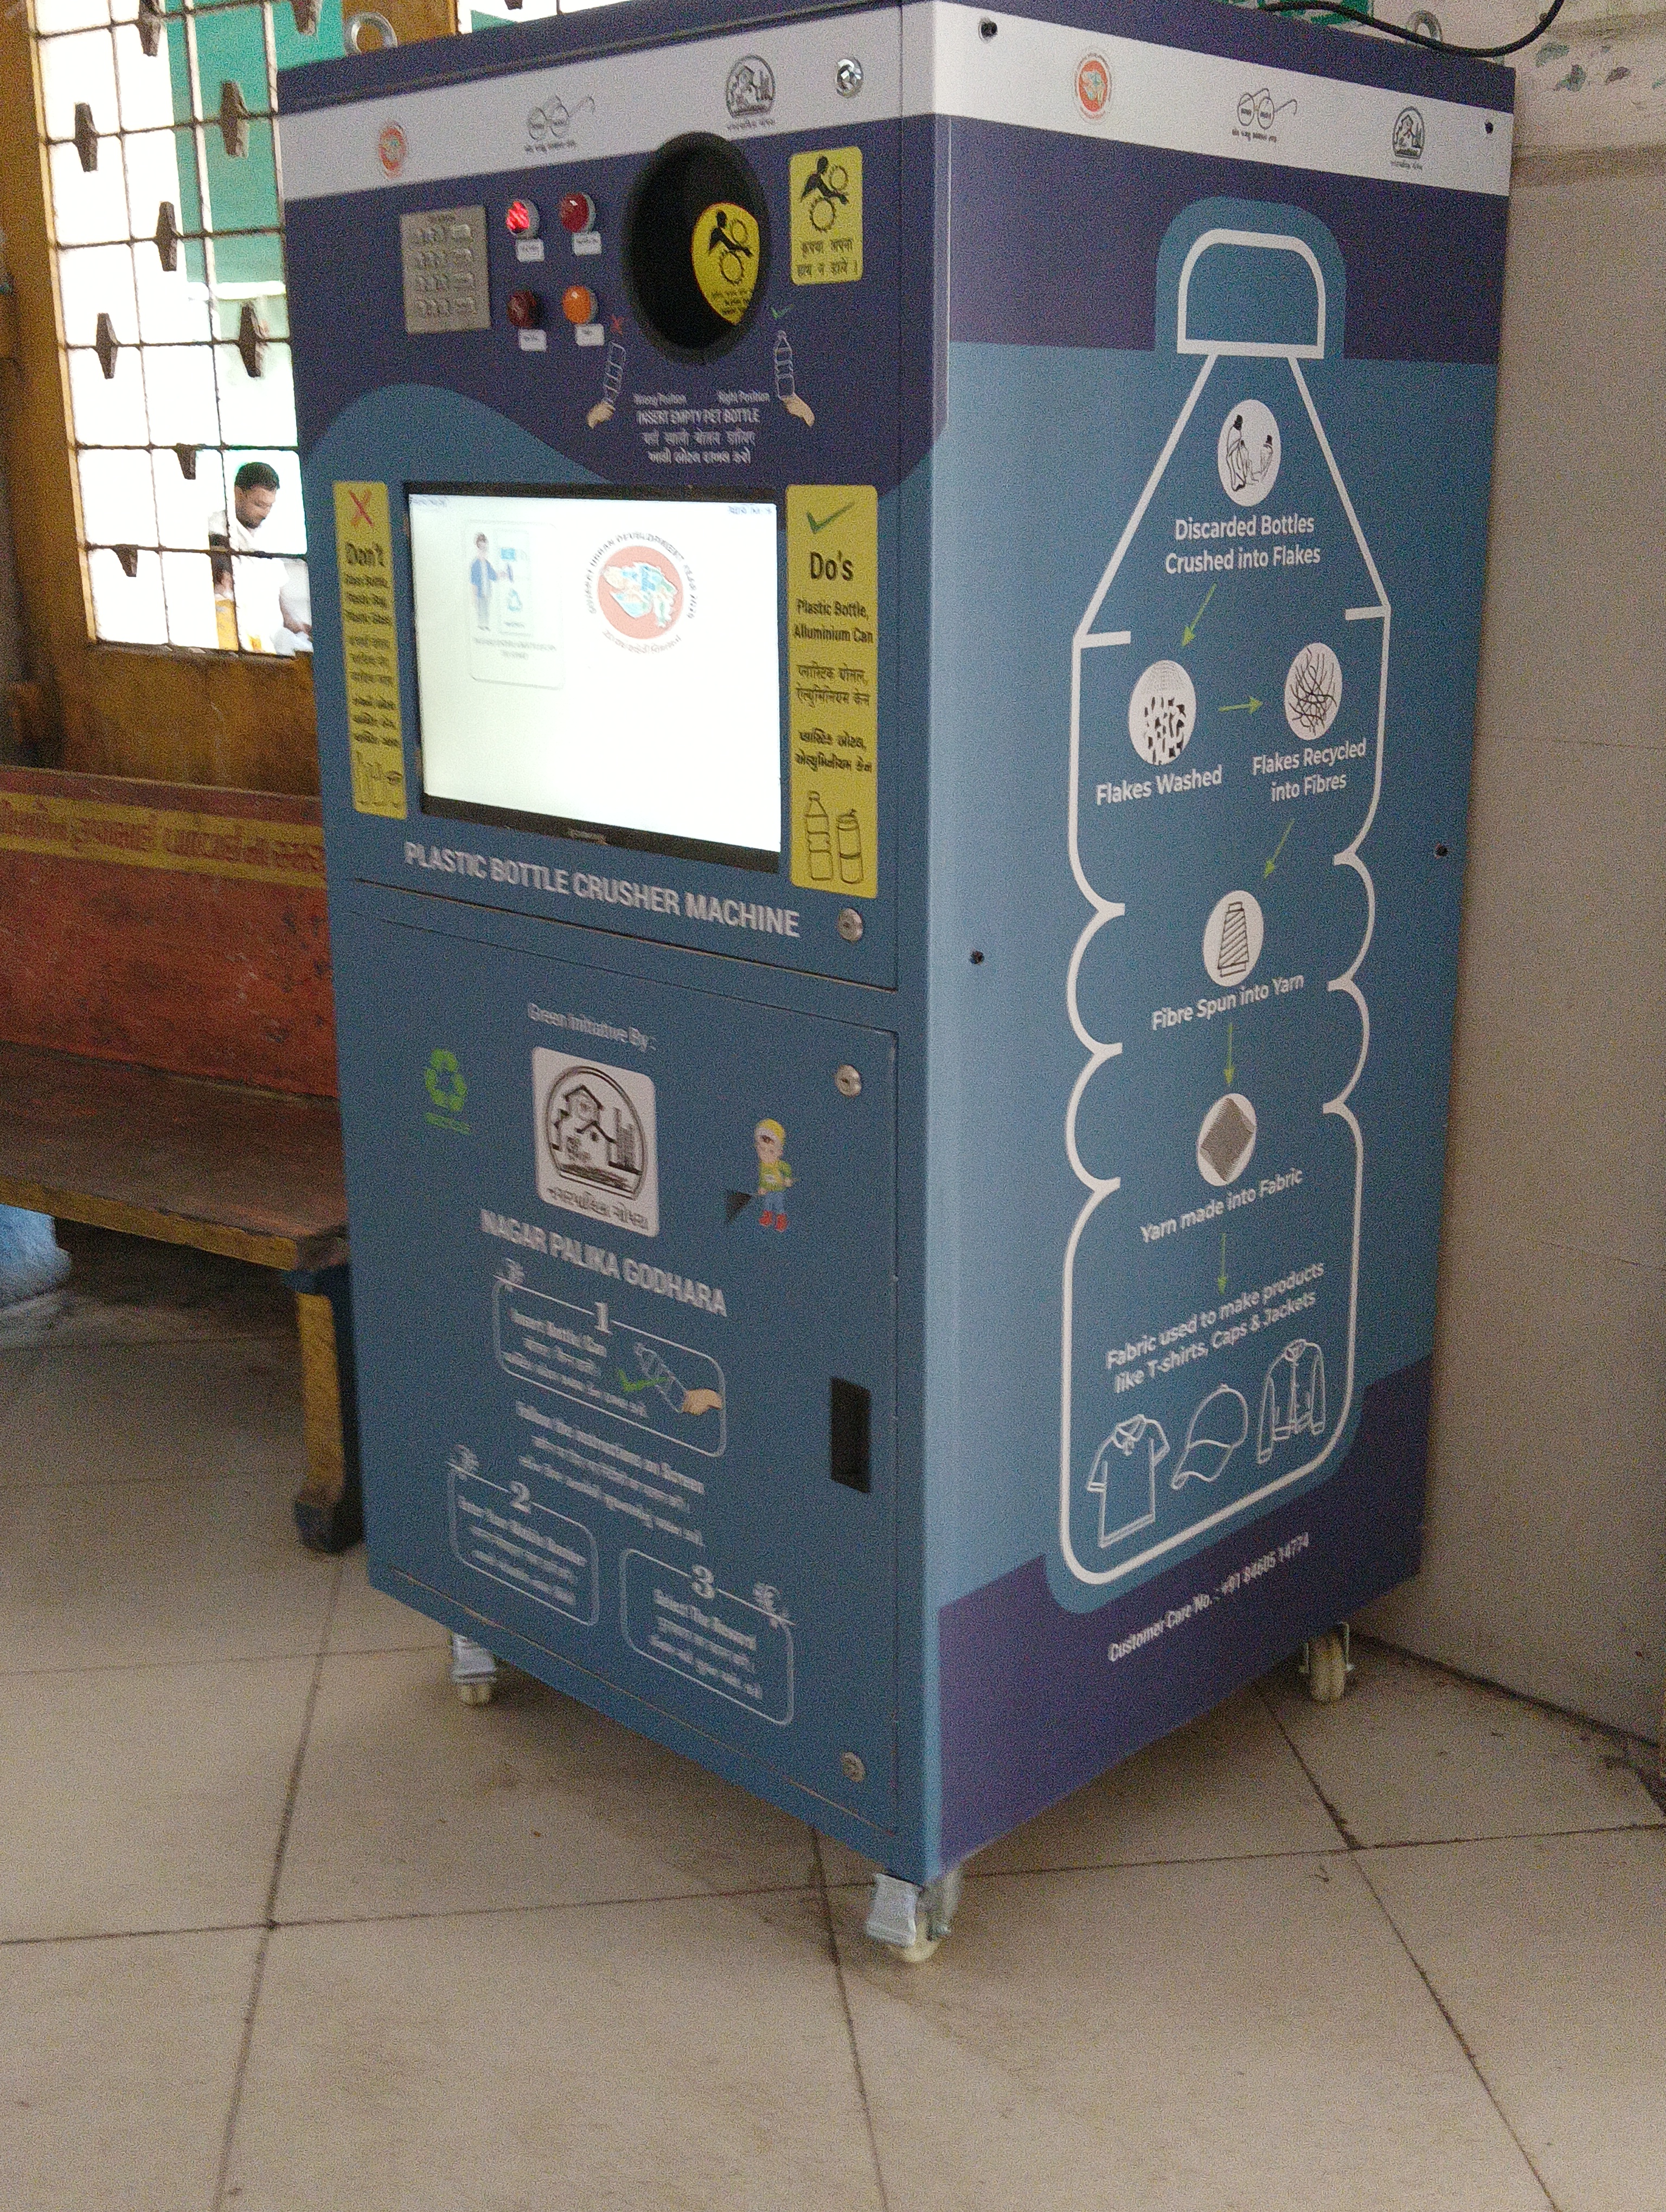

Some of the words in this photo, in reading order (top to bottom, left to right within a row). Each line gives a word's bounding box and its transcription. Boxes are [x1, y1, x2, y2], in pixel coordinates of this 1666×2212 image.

[723, 407, 760, 424] BOTTLE
[1175, 516, 1257, 541] Discarded
[1260, 513, 1315, 537] Bottles
[810, 550, 854, 581] Do's
[1164, 548, 1234, 576] Crushed
[1237, 546, 1269, 570] into
[1273, 544, 1322, 567] Flakes
[796, 598, 831, 617] Plastic
[853, 627, 874, 643] Can
[1252, 751, 1300, 776] Flakes
[1303, 737, 1367, 770] Recycled
[1096, 775, 1152, 806] Flakes
[1156, 765, 1223, 797] Washed
[1271, 779, 1301, 802] into
[1304, 771, 1347, 797] Fibres
[404, 841, 488, 880] PLASTIC
[491, 855, 569, 896] BOTTLE
[573, 872, 680, 917] CRUSHER
[684, 892, 800, 938] MACHINE
[1151, 1001, 1194, 1032] Fibre
[1196, 992, 1236, 1021] Spun
[1240, 985, 1269, 1006] into
[1273, 973, 1305, 998] Yarn
[1140, 1215, 1177, 1244] Yarn
[1181, 1198, 1225, 1229] made
[1226, 1188, 1256, 1214] into
[1259, 1167, 1303, 1198] Fabric
[480, 1208, 549, 1253] NAGAR
[549, 1226, 620, 1278] PALIKA
[622, 1256, 727, 1317] GODHARA
[594, 1301, 613, 1335] 1
[1106, 1334, 1156, 1371] Fabric
[1159, 1319, 1199, 1347] used
[1200, 1311, 1216, 1332] to
[1220, 1289, 1261, 1321] make
[1261, 1261, 1325, 1302] products
[1114, 1367, 1145, 1394] like
[1148, 1339, 1209, 1378] T-shirts,
[1212, 1322, 1248, 1352] Caps
[1250, 1315, 1261, 1332] &
[1263, 1290, 1317, 1327] Jackets
[510, 1481, 531, 1514] 2
[691, 1564, 716, 1600] 3
[1108, 1620, 1164, 1663] Customer
[1165, 1604, 1193, 1629] Care
